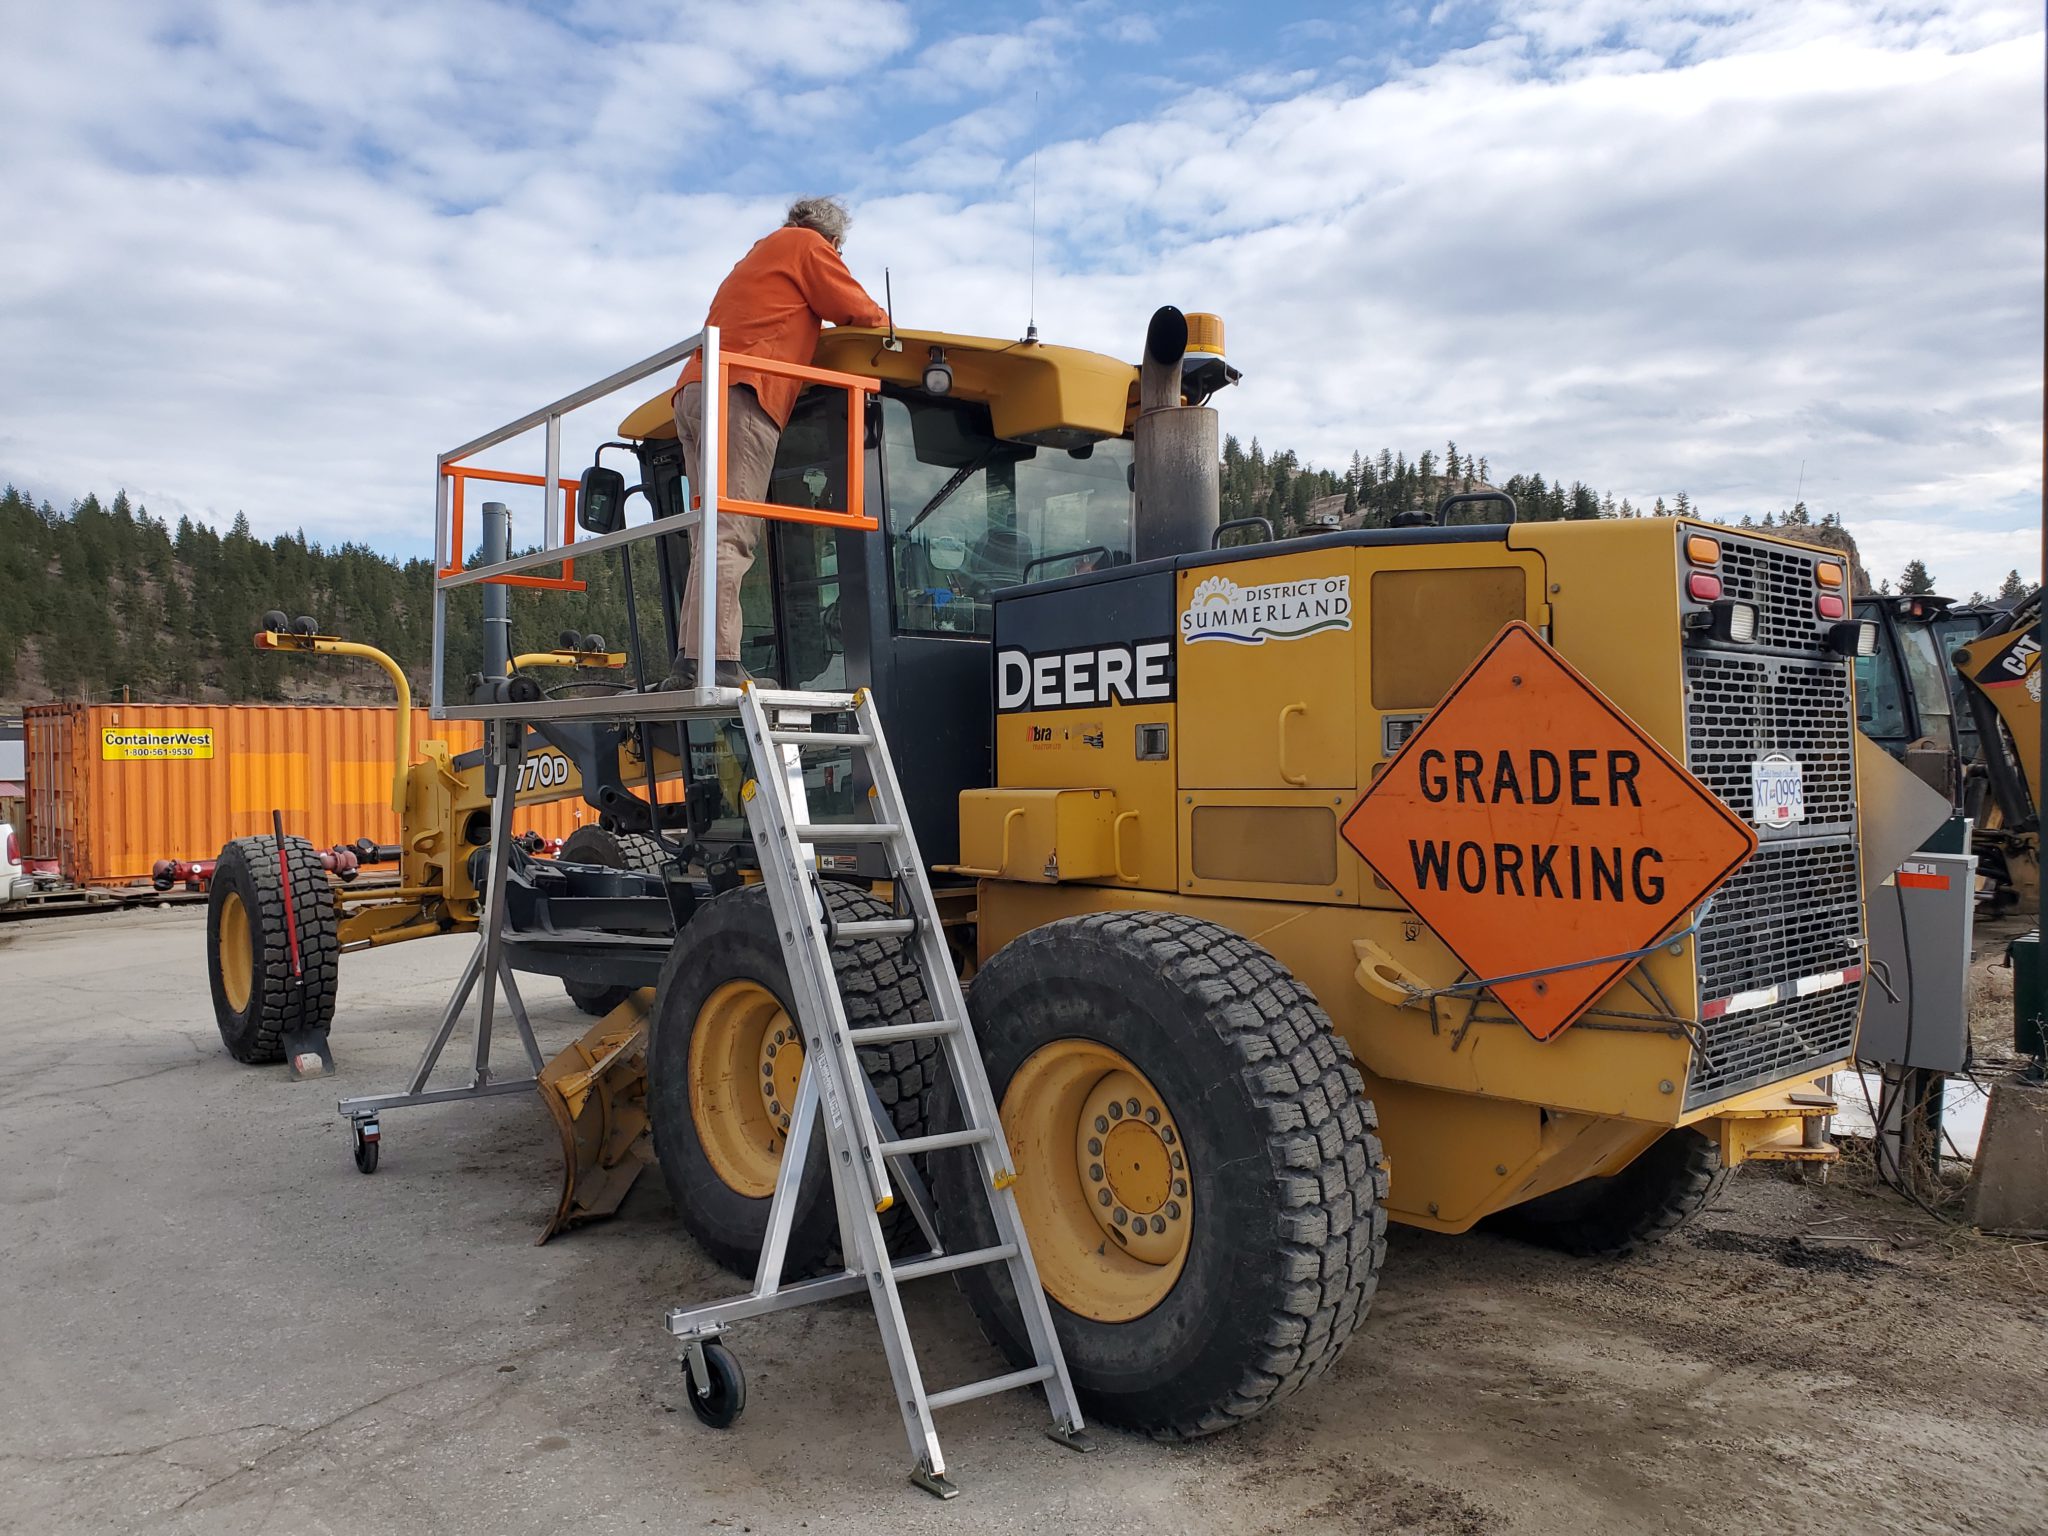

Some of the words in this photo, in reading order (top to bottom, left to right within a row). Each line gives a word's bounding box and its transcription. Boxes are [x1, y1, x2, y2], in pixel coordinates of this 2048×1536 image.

[1246, 583, 1318, 602] DISTRICT
[1324, 579, 1347, 592] OF
[1183, 597, 1348, 630] SUMMERLAND
[2002, 634, 2042, 676] CAT
[998, 642, 1170, 709] DEERE
[105, 733, 210, 745] ContainerWest
[1419, 749, 1642, 807] GRADER
[1408, 839, 1665, 905] WORKING
[1918, 864, 1934, 874] PL
